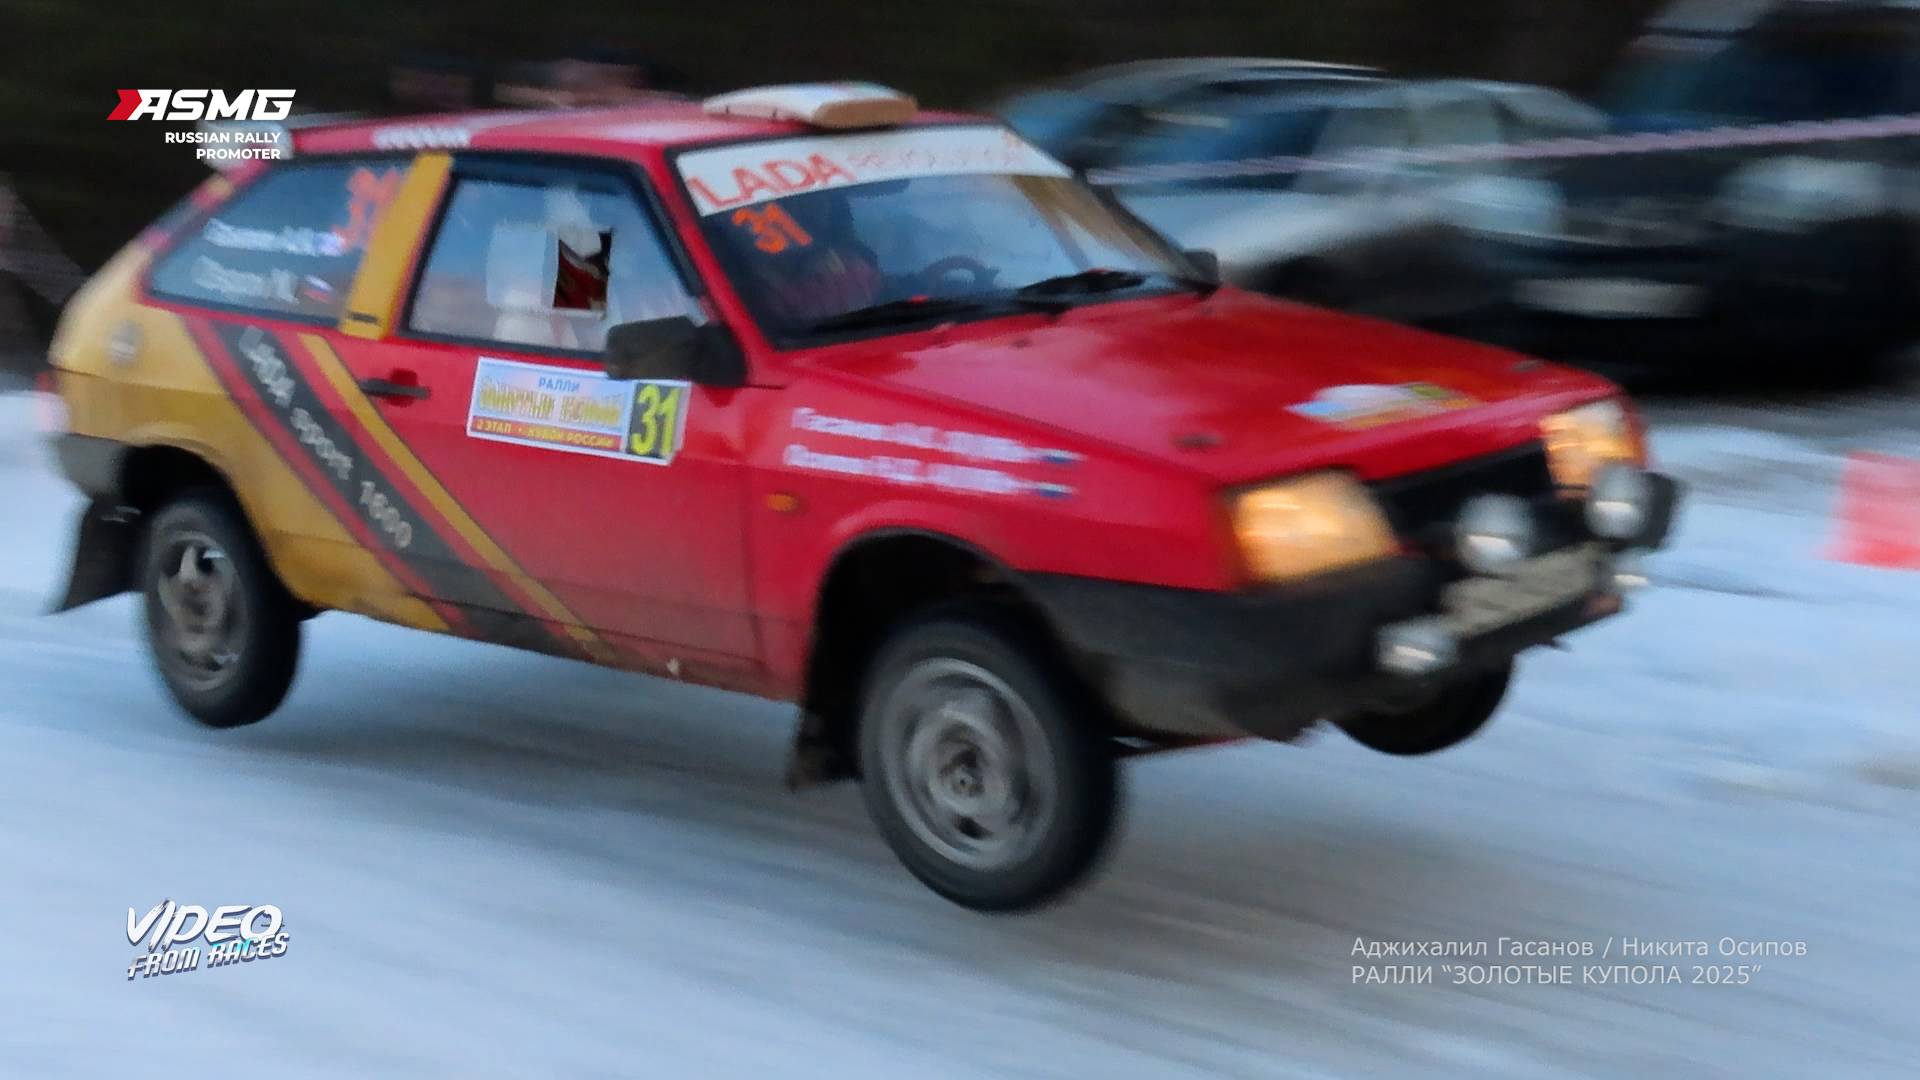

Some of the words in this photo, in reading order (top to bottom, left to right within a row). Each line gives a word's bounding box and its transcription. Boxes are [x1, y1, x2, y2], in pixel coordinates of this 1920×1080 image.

[687, 154, 856, 207] LADA
[732, 203, 812, 254] 31
[538, 377, 580, 393] РАЛЛИ
[486, 420, 512, 434] ЭТАП
[631, 384, 682, 456] 31
